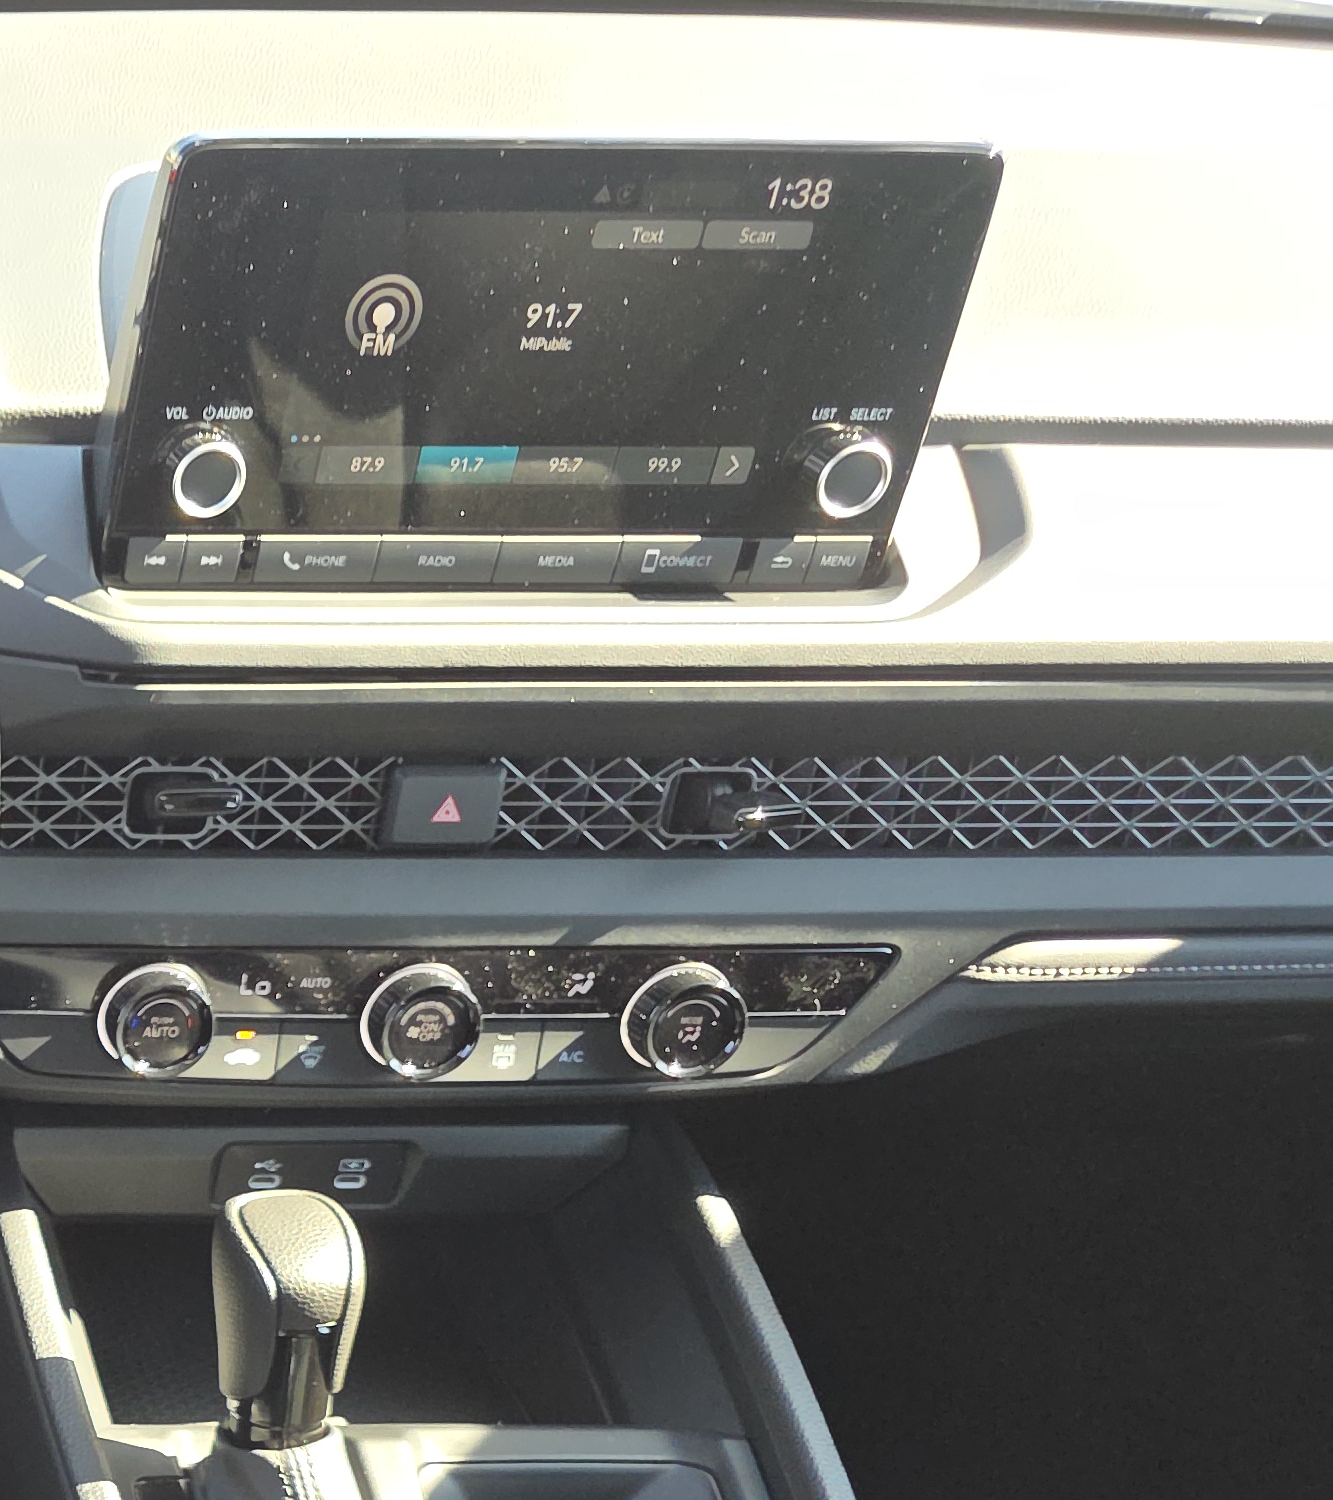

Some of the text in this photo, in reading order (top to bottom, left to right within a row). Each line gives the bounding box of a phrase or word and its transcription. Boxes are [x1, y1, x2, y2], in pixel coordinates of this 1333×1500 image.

[767, 177, 833, 209] 1:38
[633, 226, 664, 243] Text
[739, 227, 776, 243] Scan
[526, 303, 582, 328] 91.7
[359, 333, 396, 356] FM
[166, 406, 189, 420] VOL
[215, 406, 253, 420] AUDIO
[811, 407, 837, 420] LIST
[850, 407, 893, 420] SELECT
[350, 457, 384, 472] 87.9
[450, 457, 483, 473] 91.7
[549, 457, 583, 473] 95.7
[648, 457, 682, 473] 99.9
[304, 555, 346, 567] PHONE
[418, 555, 455, 567] RADIO
[538, 555, 574, 567] MEDIA
[659, 554, 712, 568] CONNECT
[820, 555, 856, 567] MENU
[300, 977, 331, 988] AUTO
[142, 1026, 180, 1039] AUTO
[558, 1050, 584, 1063] A/C
